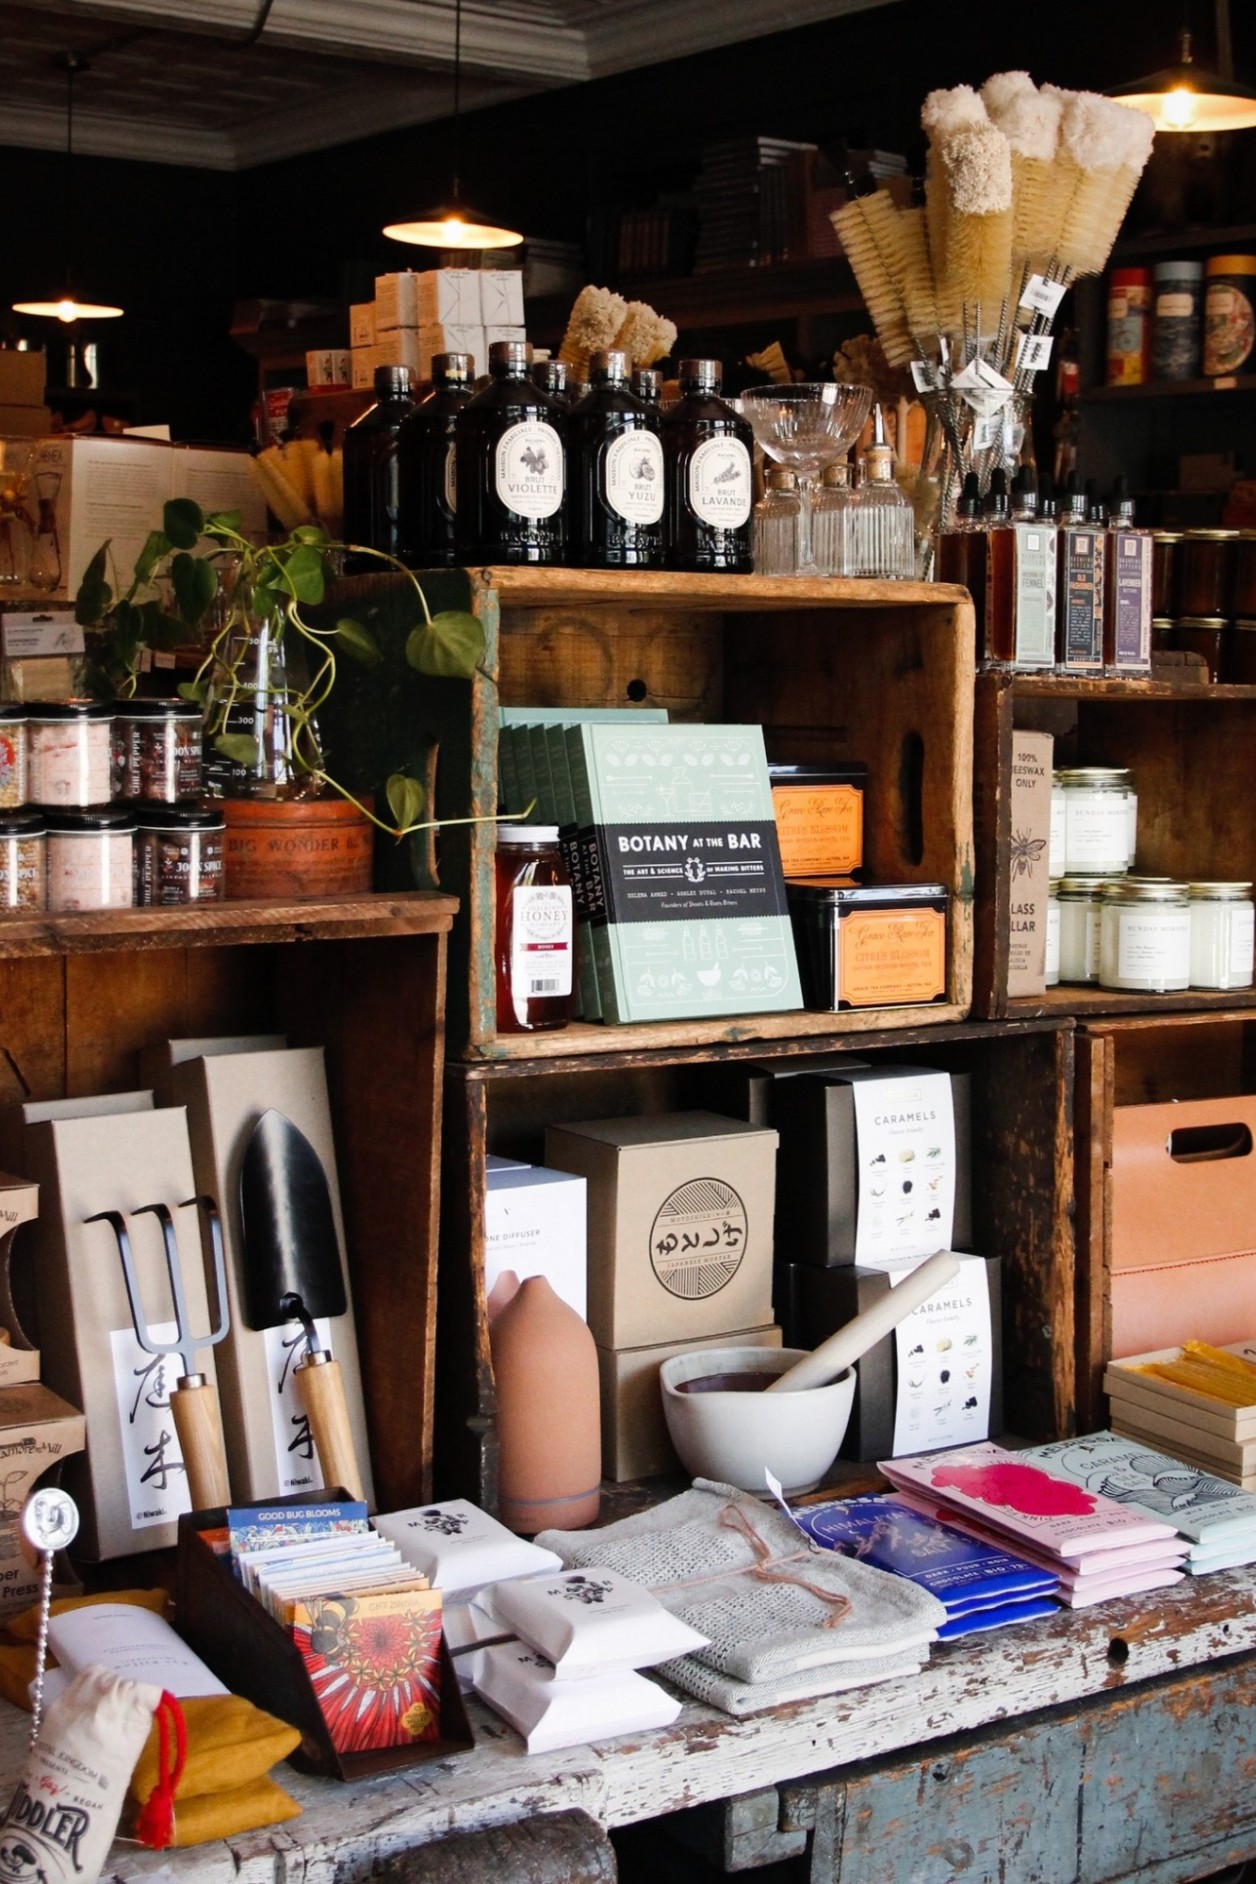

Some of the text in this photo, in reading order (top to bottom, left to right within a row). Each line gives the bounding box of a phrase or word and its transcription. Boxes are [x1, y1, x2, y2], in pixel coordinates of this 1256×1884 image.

[525, 476, 545, 484] BRUT
[508, 484, 558, 495] VIOLETTE
[634, 483, 652, 491] BRUT
[717, 489, 736, 497] BRUT
[629, 491, 656, 502] YUZU
[702, 496, 747, 507] LAVANDE
[1022, 579, 1044, 589] FENNEL
[131, 731, 140, 795] CHILI PEPPER
[1017, 753, 1037, 763] 100%
[232, 768, 247, 776] 100
[1012, 766, 1045, 776] EESWAX
[1016, 779, 1036, 789] ONLY
[1075, 809, 1105, 817] SUNDAY
[780, 825, 807, 836] ITRUS
[228, 838, 257, 852] BIG
[269, 837, 340, 852] WONDER
[618, 833, 762, 852] BOTANY AT THE BAR
[144, 845, 153, 882] PEPPER
[570, 841, 585, 905] BOTANY
[589, 842, 604, 907] BOTANY
[657, 867, 683, 875] SCIENCE
[714, 865, 739, 873] MAKING
[586, 881, 597, 912] BAR
[1010, 903, 1035, 915] LASS
[520, 910, 568, 922] HONEY
[1010, 920, 1036, 932] LLAR
[891, 949, 931, 960] BLOSSOM
[874, 1110, 937, 1126] CARAMELS
[486, 1229, 540, 1242] ONE DIFFUSER
[667, 1254, 731, 1268] JAPANESE MORTAR
[911, 1297, 973, 1316] CARAMELS
[1115, 1473, 1137, 1482] SEA
[258, 1508, 341, 1521] GOOD BUG BLOOMS
[1185, 1507, 1203, 1516] MILK
[1188, 1504, 1255, 1525] CHOCOLATE BIO
[1050, 1519, 1073, 1529] DARK
[1054, 1517, 1128, 1537] CHOCOLATE BIO
[0, 1569, 19, 1584] per
[924, 1568, 950, 1579] DARK
[956, 1563, 980, 1573] PUUR
[929, 1571, 979, 1587] CHOCOLATE
[984, 1566, 1006, 1577] BIO
[3, 1584, 39, 1598] Press
[368, 1597, 419, 1612] GIFT ZINNIA
[73, 1795, 104, 1811] REGAN
